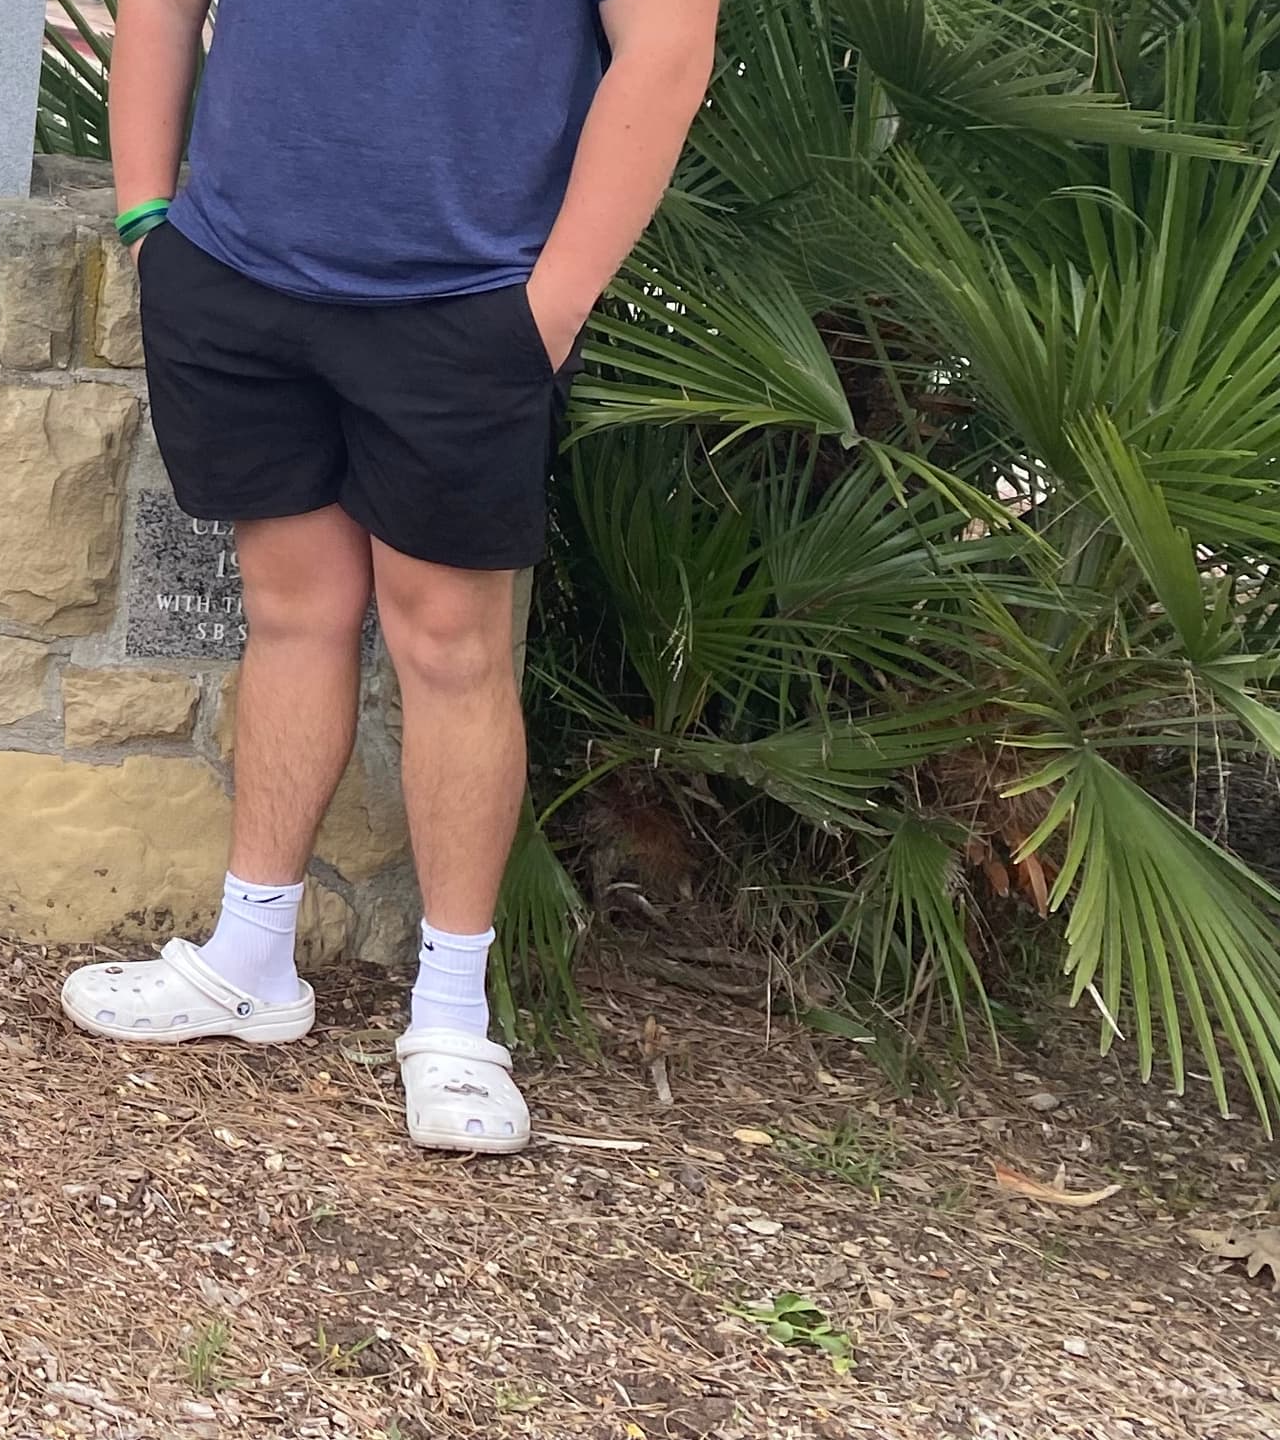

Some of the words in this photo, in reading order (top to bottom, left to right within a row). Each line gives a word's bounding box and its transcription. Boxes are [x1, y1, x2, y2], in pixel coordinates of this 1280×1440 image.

[192, 518, 235, 536] CL
[155, 594, 211, 613] WITH
[195, 622, 225, 640] SB
